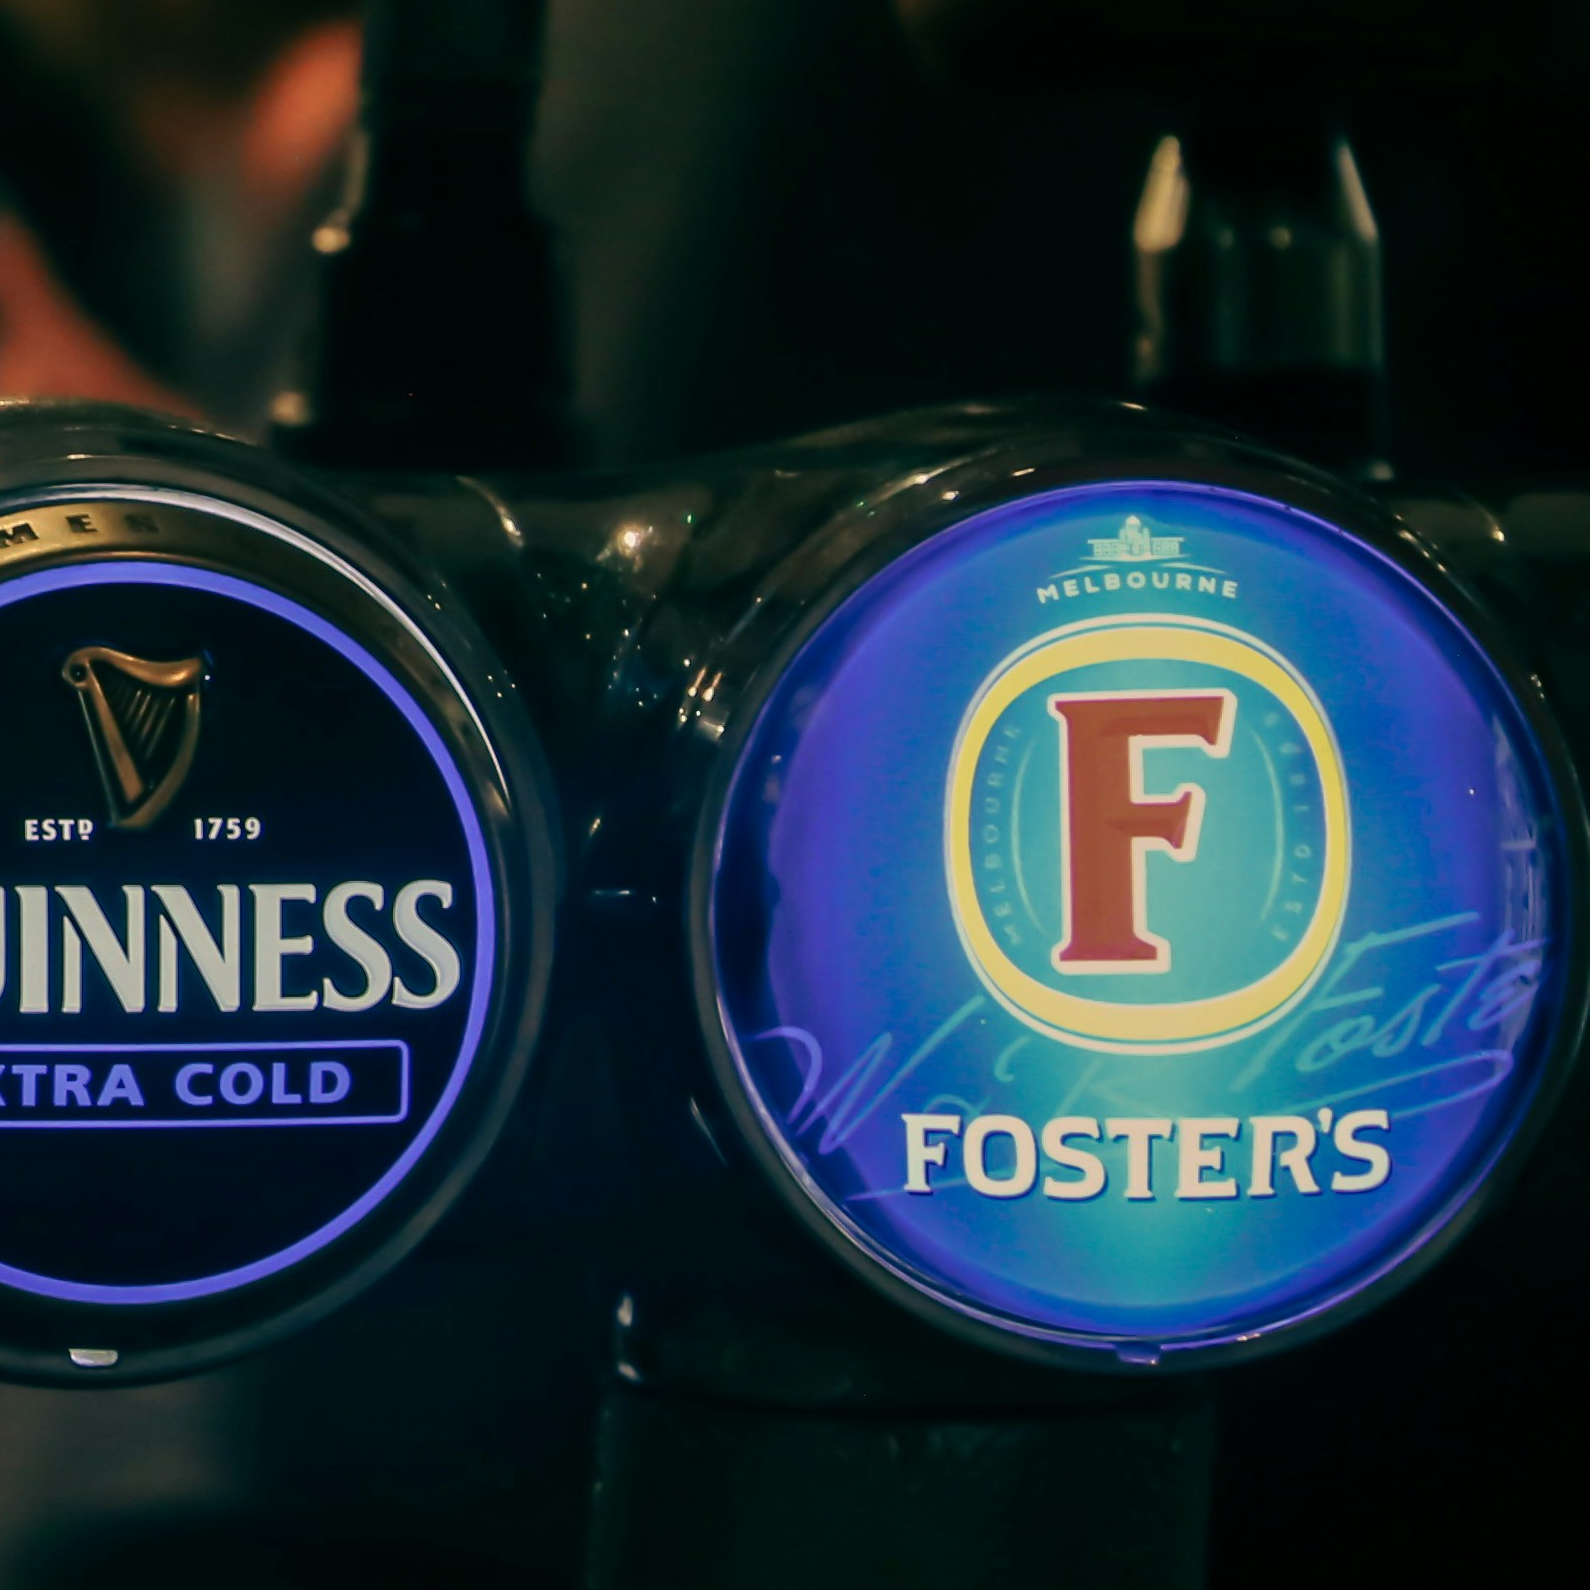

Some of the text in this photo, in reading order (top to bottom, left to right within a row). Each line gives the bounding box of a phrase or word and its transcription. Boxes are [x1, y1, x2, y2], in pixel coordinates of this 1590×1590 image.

[1036, 570, 1239, 604] MELBOURNE
[193, 817, 262, 841] 1759
[1049, 690, 1235, 972] F
[173, 1060, 354, 1107] COLD
[900, 1108, 1392, 1200] FOSTER'S
